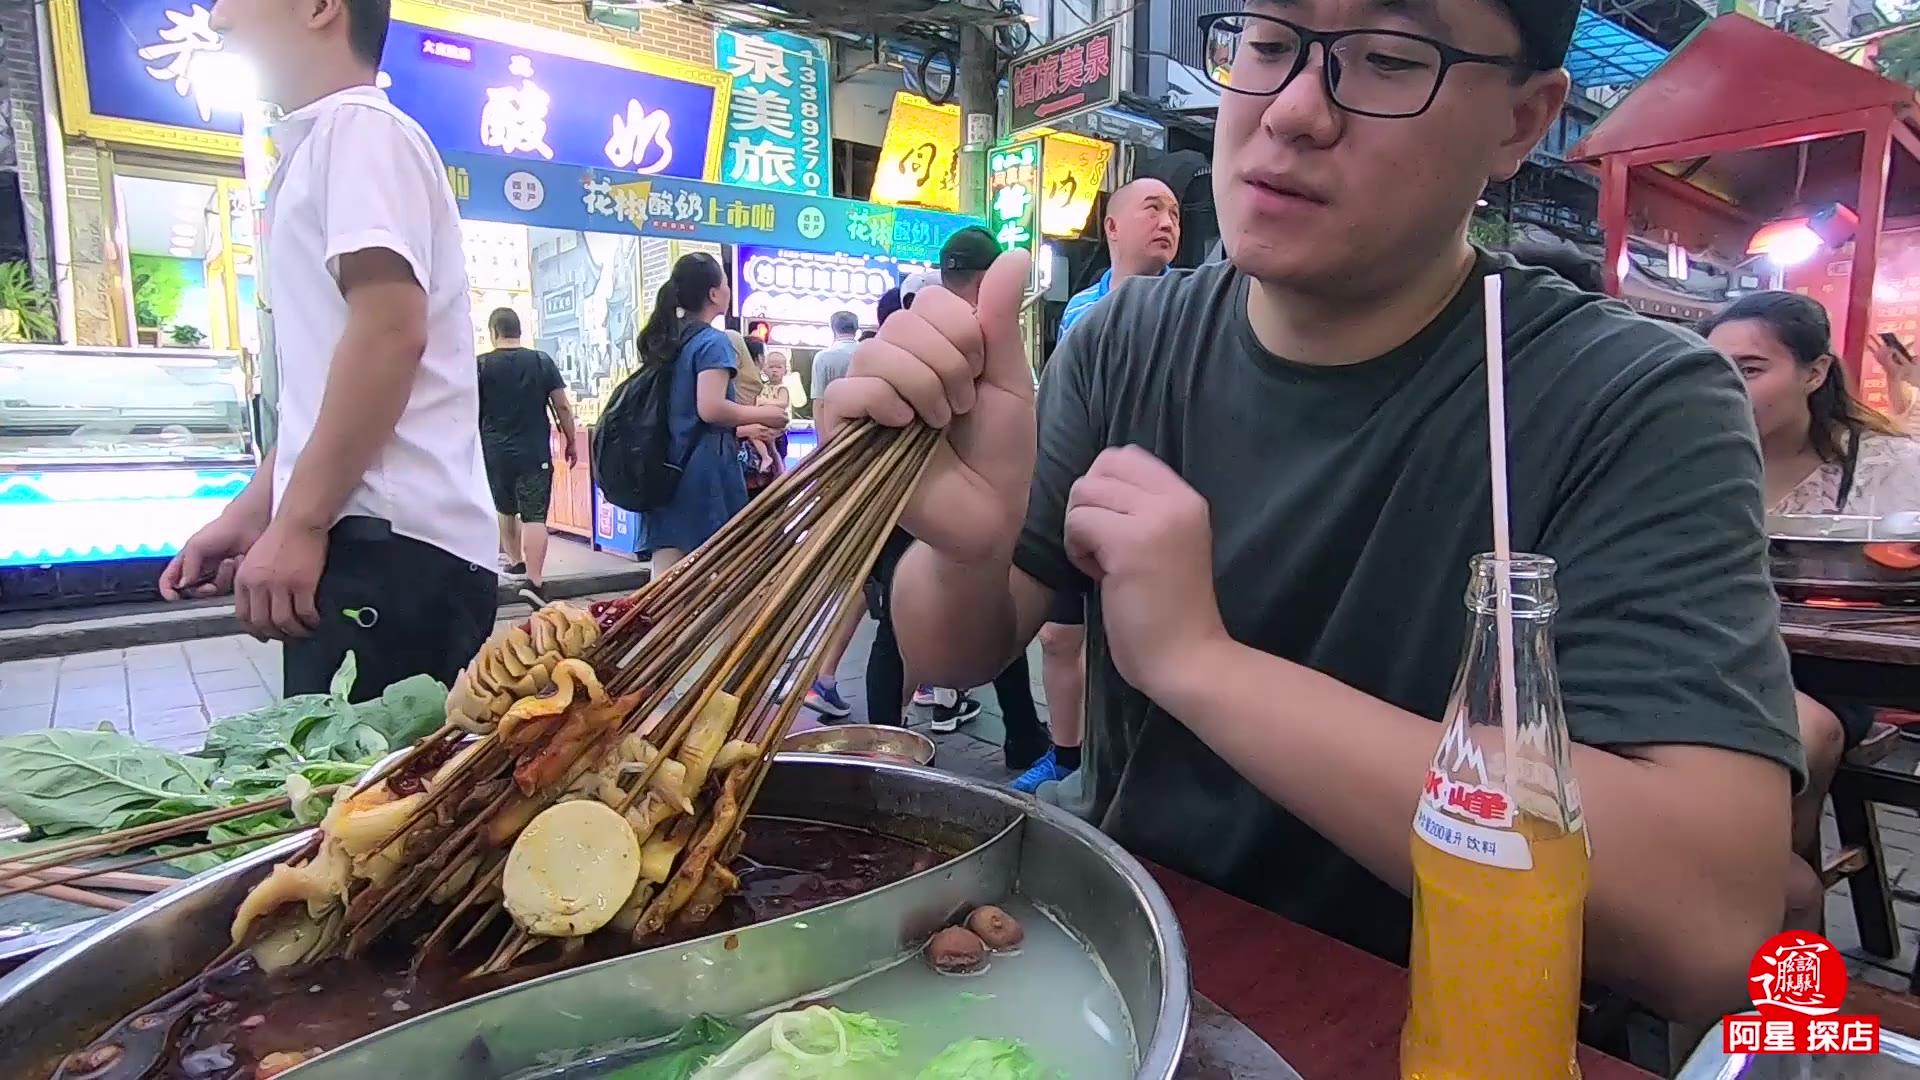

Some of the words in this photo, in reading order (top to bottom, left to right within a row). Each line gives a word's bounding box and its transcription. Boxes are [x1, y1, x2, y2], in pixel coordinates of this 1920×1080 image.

[726, 33, 797, 187] 泉美旅
[800, 50, 820, 196] 13389270
[1466, 835, 1496, 857] 饮料
